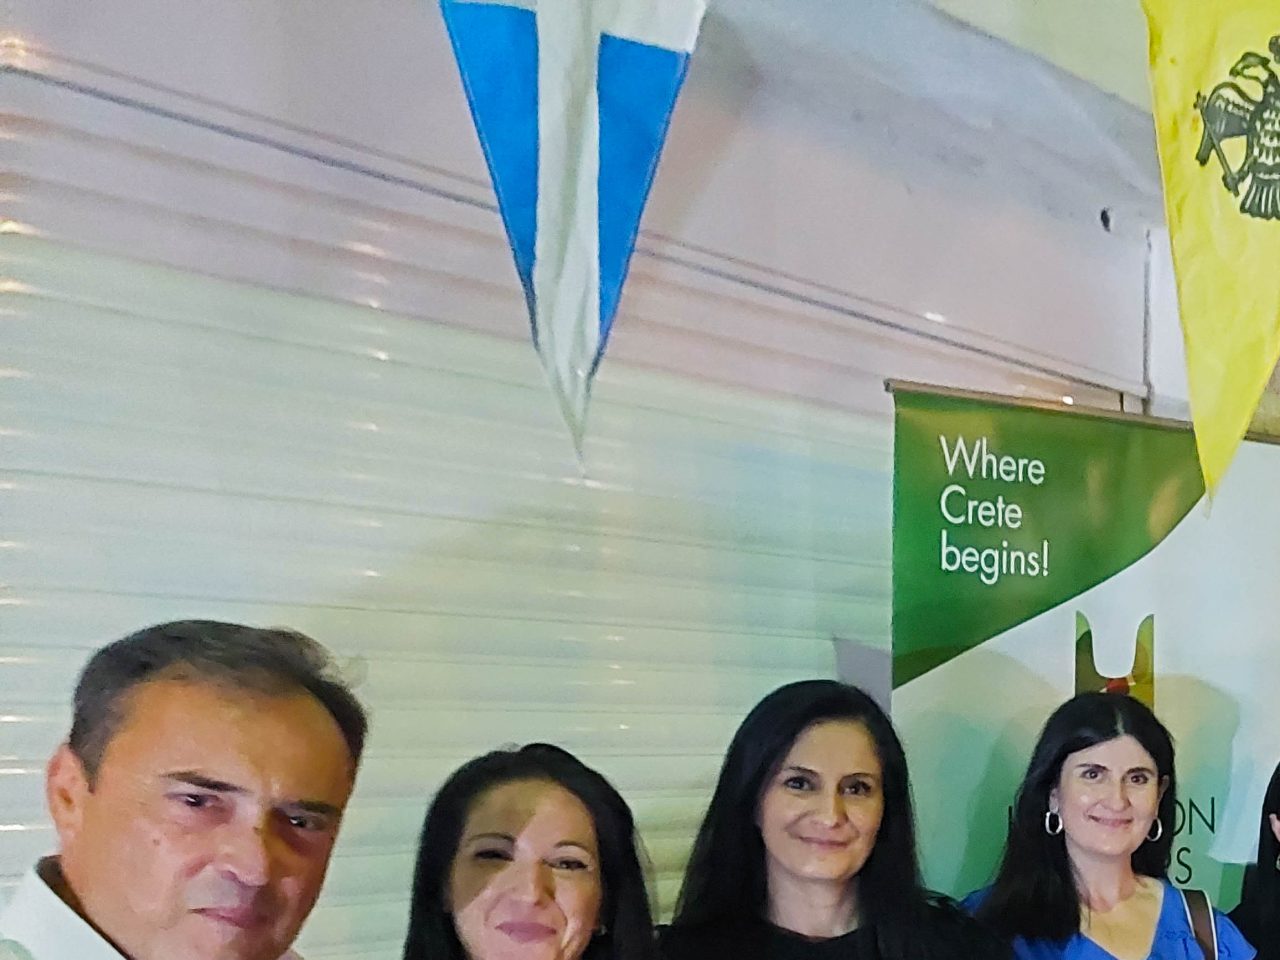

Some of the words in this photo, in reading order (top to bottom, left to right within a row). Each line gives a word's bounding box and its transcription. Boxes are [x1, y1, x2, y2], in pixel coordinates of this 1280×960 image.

[939, 434, 1046, 485] Where
[940, 484, 1022, 529] Crete
[941, 529, 1049, 585] begins!
